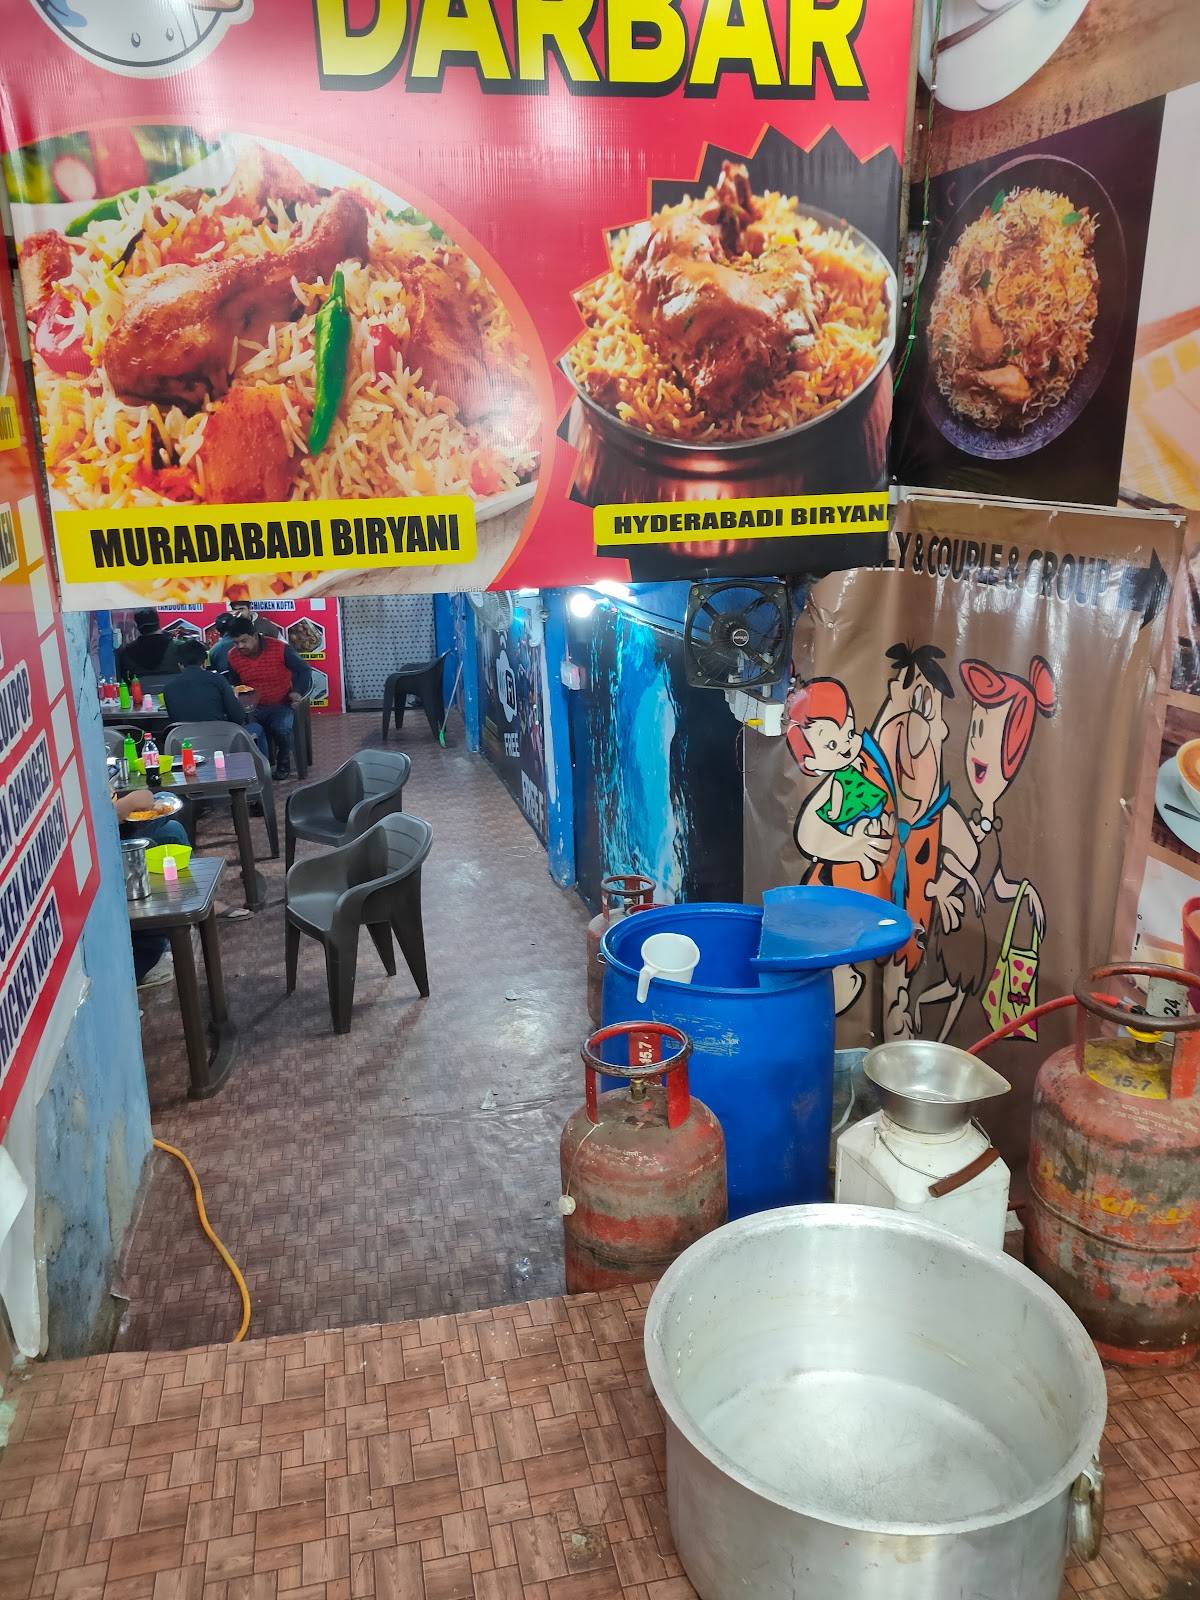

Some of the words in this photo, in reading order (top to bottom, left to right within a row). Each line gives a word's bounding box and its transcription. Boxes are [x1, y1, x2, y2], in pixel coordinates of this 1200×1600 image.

[316, 0, 869, 100] DARBAR
[90, 518, 324, 569] MURADABADI
[330, 513, 461, 558] BIRYANI
[613, 508, 784, 535] HYDERABADI
[926, 534, 1003, 587] COUPLE
[250, 601, 275, 610] CHICKEN
[276, 600, 295, 610] KOFTA
[9, 740, 51, 836] CHANGEZI
[20, 796, 67, 913] KALIMIRCH
[31, 892, 62, 982] KOFTA
[1163, 998, 1181, 1017] 24
